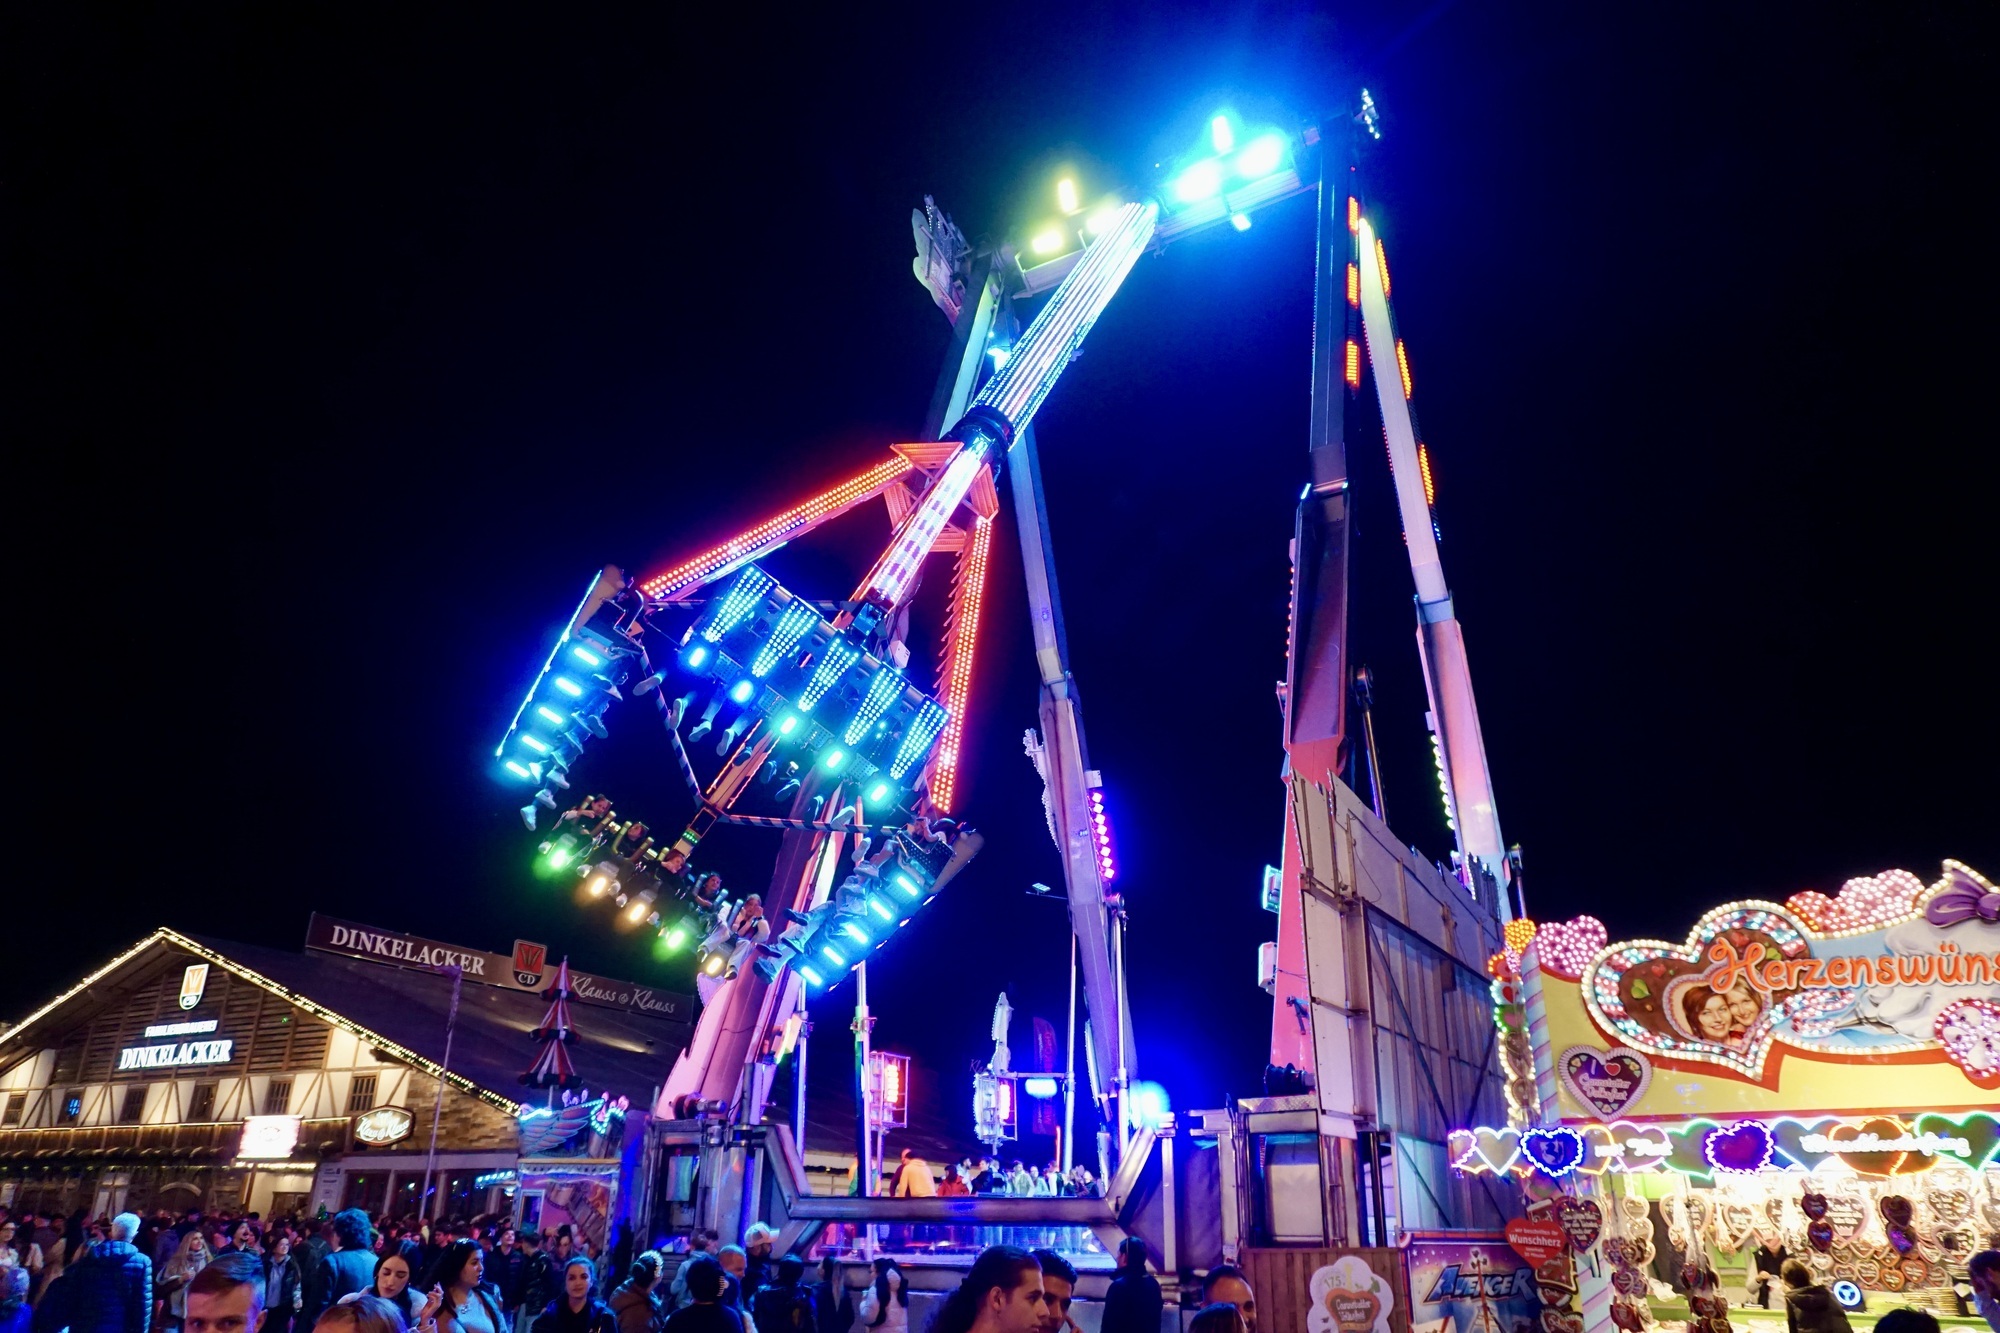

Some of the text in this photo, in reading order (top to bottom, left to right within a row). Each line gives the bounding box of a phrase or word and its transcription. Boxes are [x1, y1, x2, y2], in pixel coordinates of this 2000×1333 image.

[330, 925, 485, 976] DINKELACKER
[518, 973, 536, 985] CD
[571, 975, 618, 1003] Klauss
[629, 988, 675, 1014] Klauss
[118, 1039, 233, 1069] DINKELACKER
[1591, 1059, 1596, 1075] I
[1579, 1072, 1632, 1089] Cannstatter
[1583, 1086, 1628, 1102] Volksfest
[1509, 1234, 1561, 1247] Wunschherz
[1423, 1264, 1537, 1303] AVENGER
